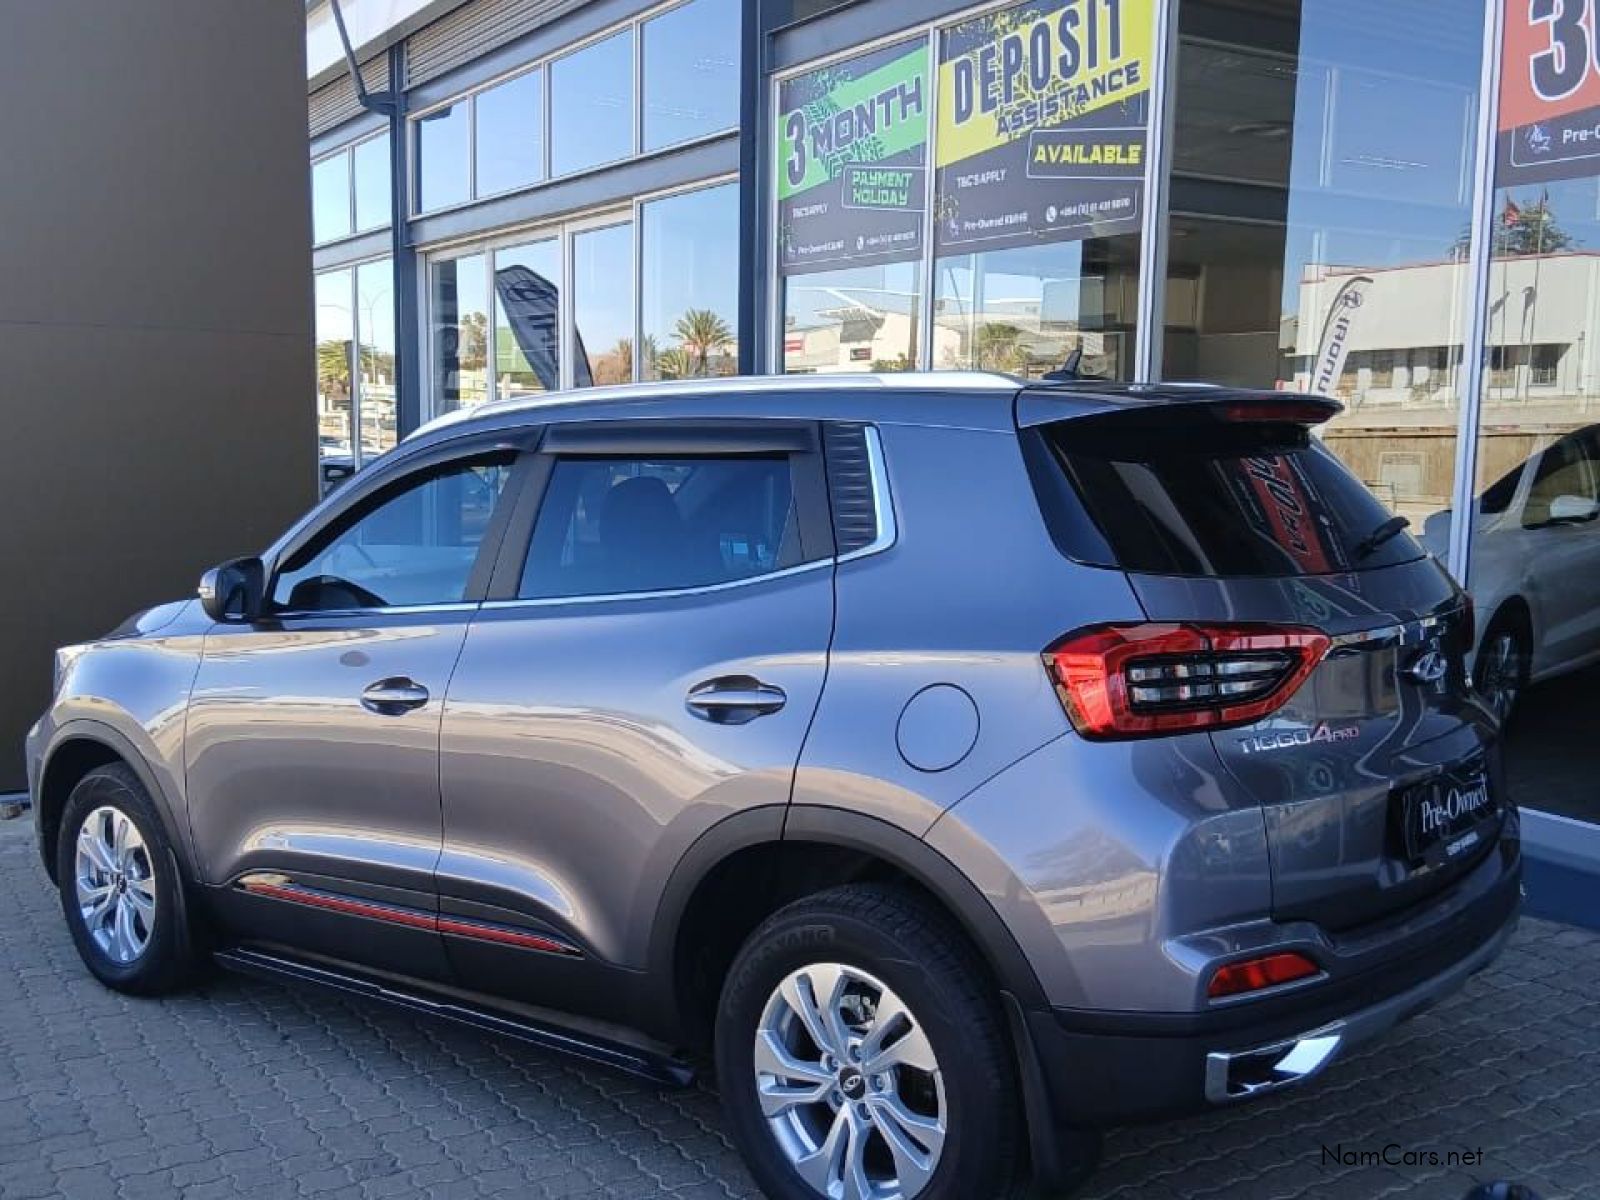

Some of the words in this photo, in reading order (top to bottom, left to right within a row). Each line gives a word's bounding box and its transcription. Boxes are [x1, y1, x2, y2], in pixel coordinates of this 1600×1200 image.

[954, 0, 1122, 125] DEPOSIT
[1528, 0, 1600, 102] 3
[785, 108, 807, 188] 3
[812, 77, 923, 158] MONTH
[996, 60, 1140, 137] ASSISTANCE
[852, 171, 912, 188] PAYMENT
[1032, 143, 1143, 165] AVAILABLE
[852, 188, 908, 206] HOLIDAY
[1421, 773, 1489, 832] Pre-Owned
